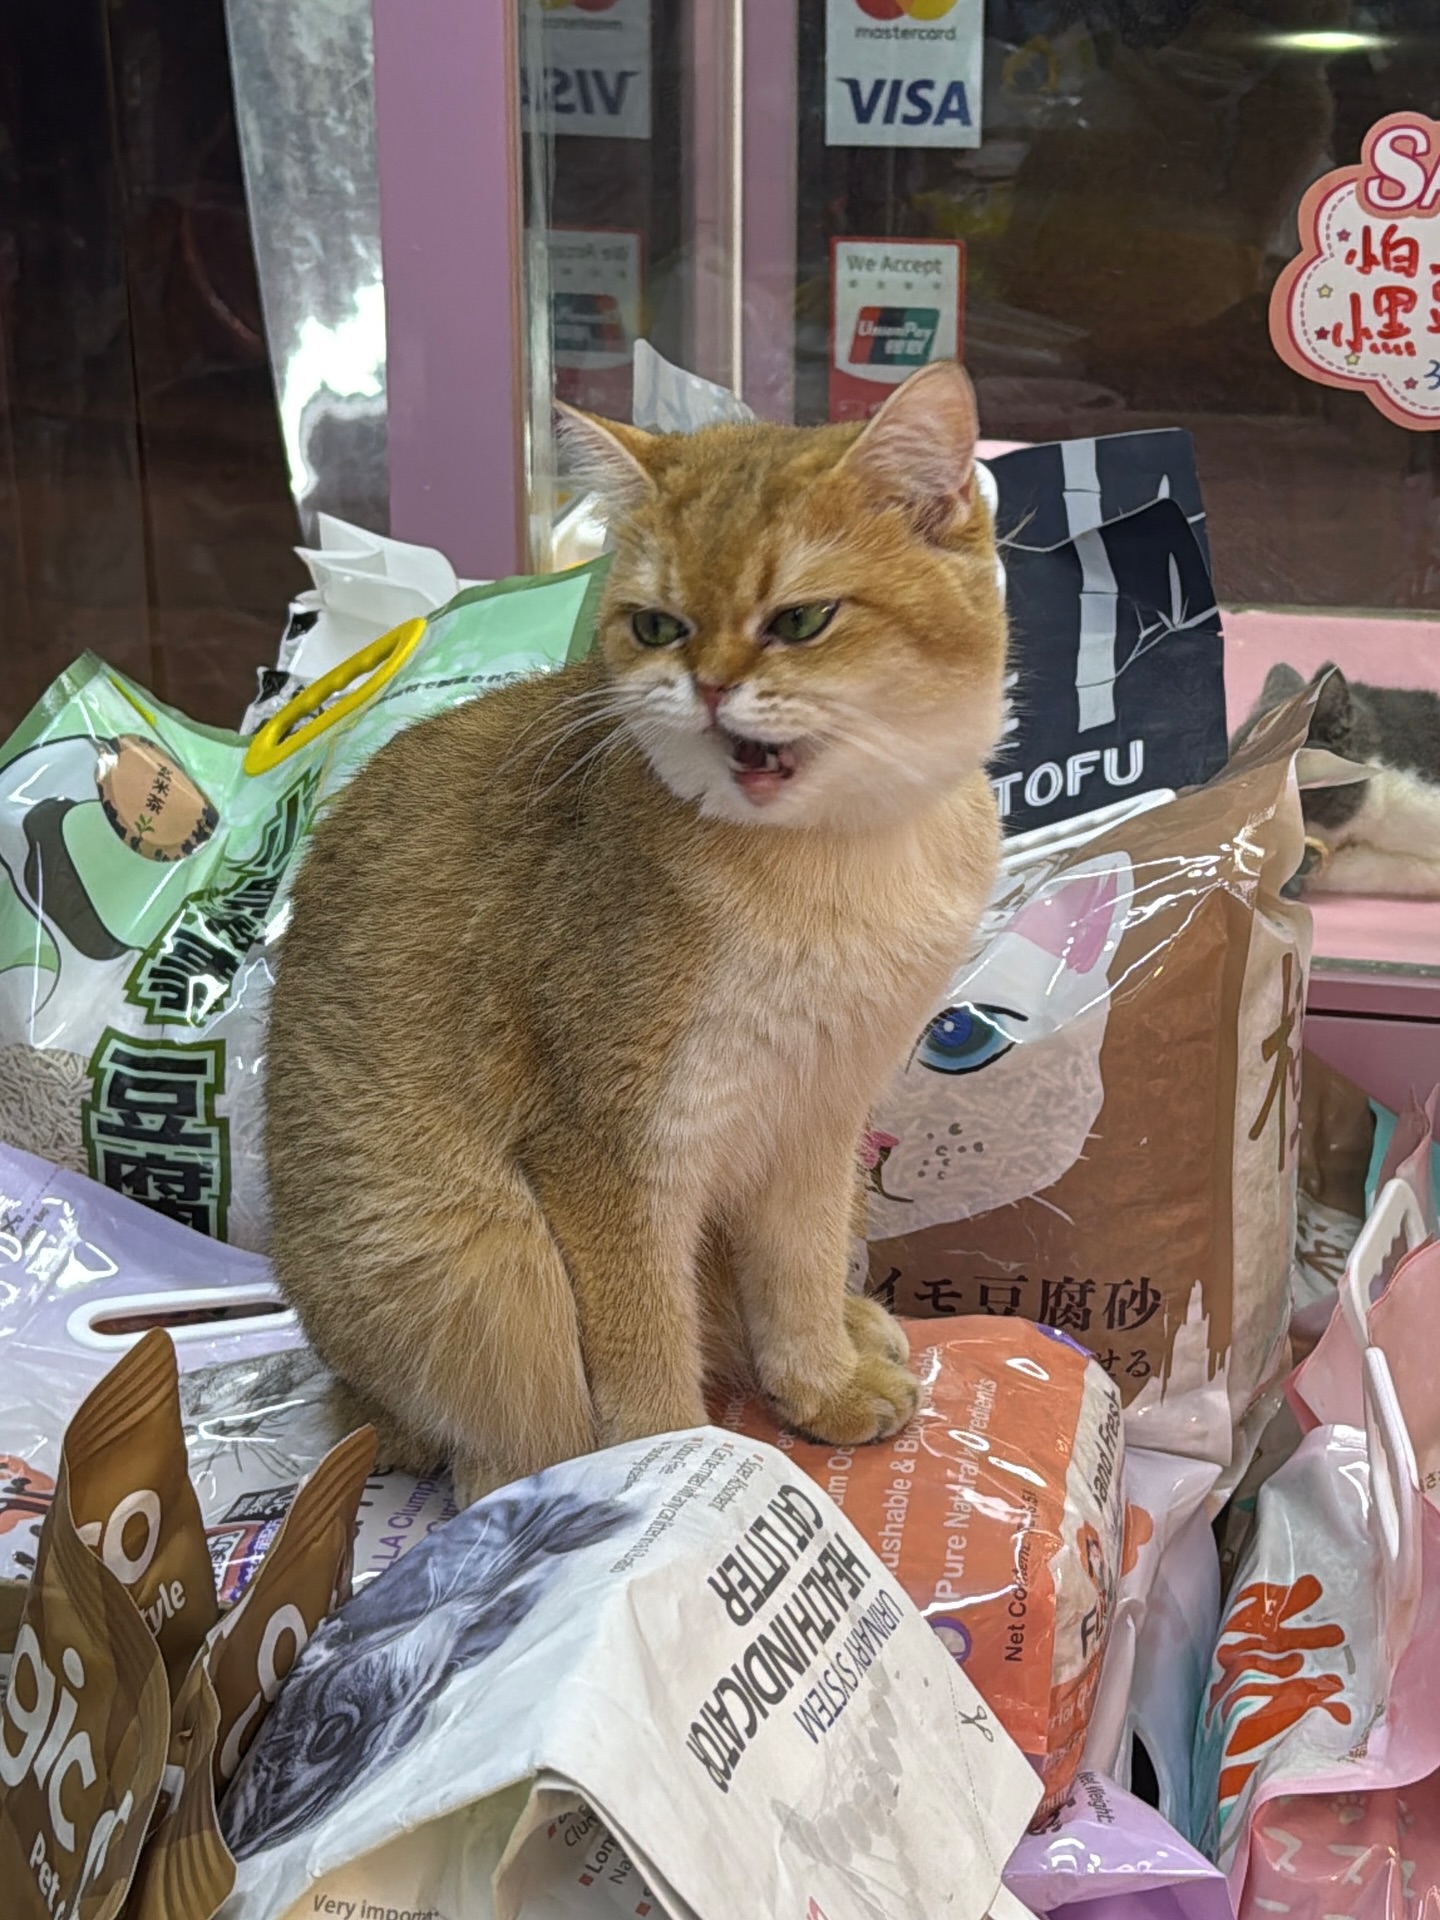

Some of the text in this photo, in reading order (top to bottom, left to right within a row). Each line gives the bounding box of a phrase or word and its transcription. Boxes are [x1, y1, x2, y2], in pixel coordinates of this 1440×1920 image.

[855, 26, 956, 40] mastercard
[835, 78, 971, 126] VISA
[847, 255, 943, 277] We Accept
[992, 740, 1143, 816] TOFU
[387, 1462, 441, 1530] Clump
[889, 1458, 916, 1473] &
[367, 1534, 408, 1573] LLA
[707, 1484, 823, 1626] CAT LITTER
[879, 1480, 913, 1572] ushable
[934, 1533, 968, 1598] Pure
[686, 1531, 872, 1793] HEALTH INDICATOR
[793, 1588, 904, 1745] URINARY SYSTEM
[1005, 1623, 1025, 1662] Net
[30, 1830, 60, 1912] Pet
[313, 1894, 356, 1920] Very
